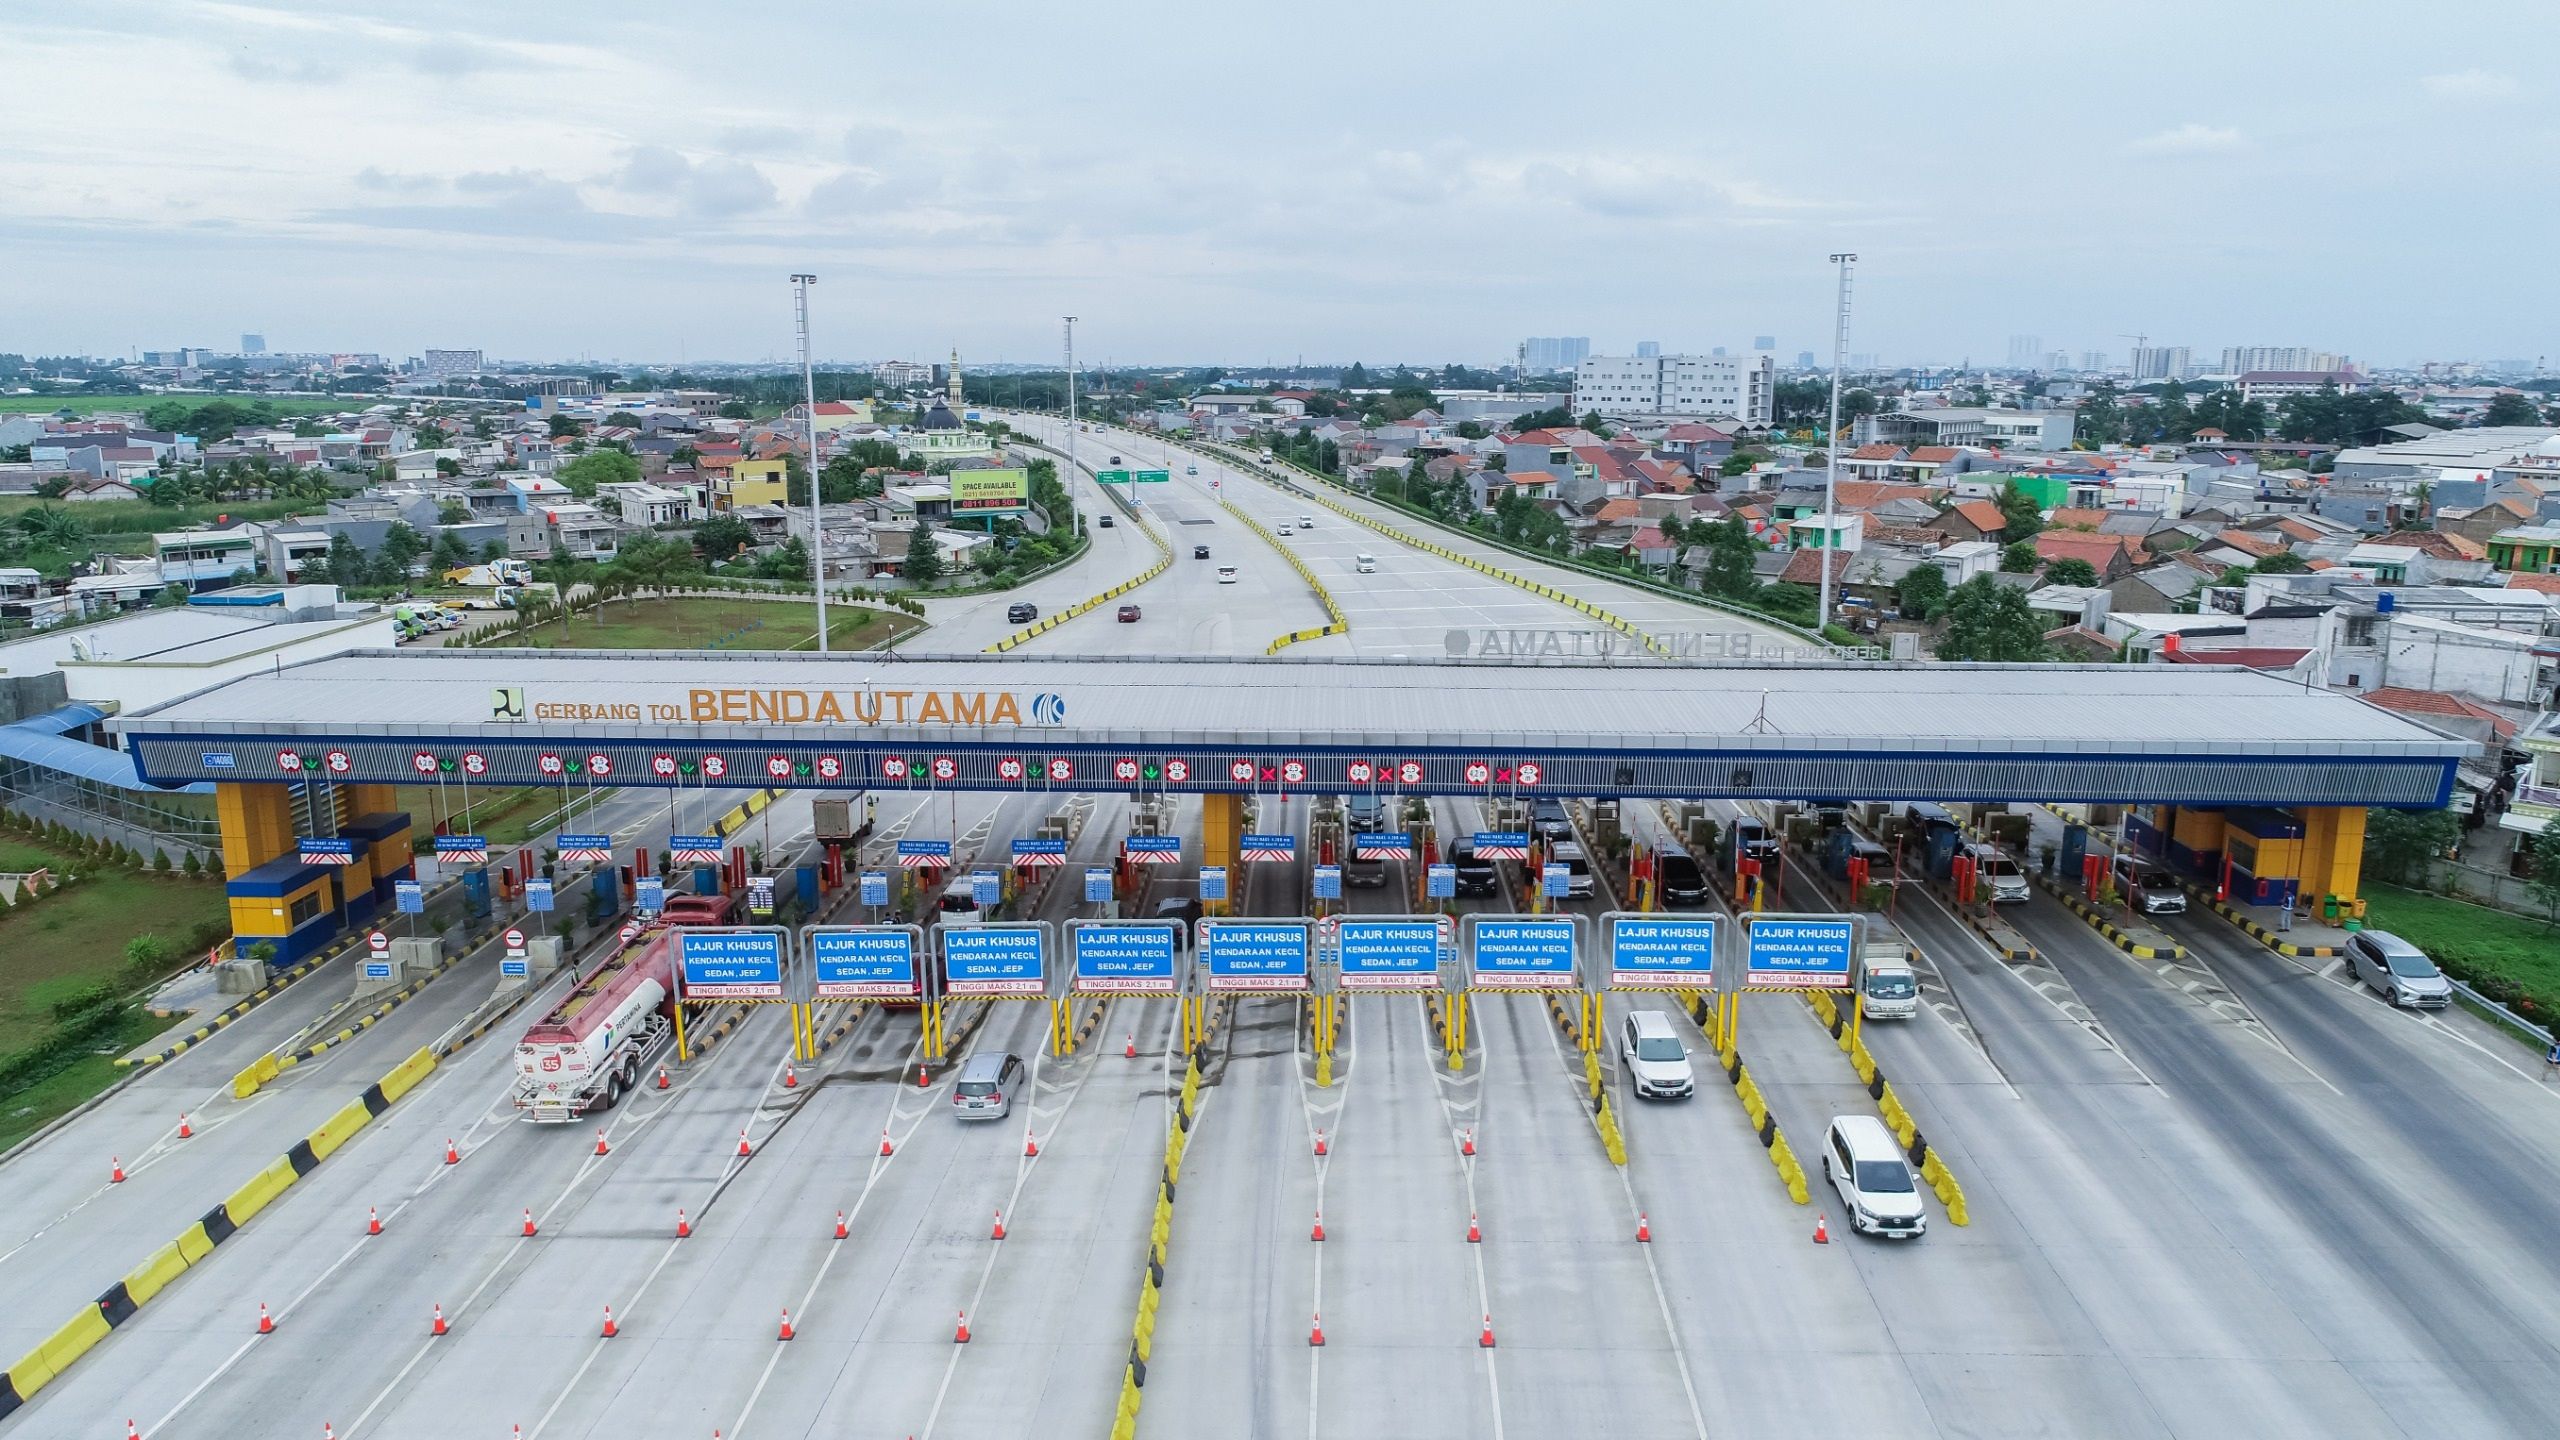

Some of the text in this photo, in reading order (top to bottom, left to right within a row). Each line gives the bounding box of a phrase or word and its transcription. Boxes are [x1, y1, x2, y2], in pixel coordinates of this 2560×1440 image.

[535, 690, 1023, 724] GERBANG TOL BENDA UTAMA
[1213, 933, 1302, 942] LAJUR KHUSUS
[1344, 930, 1433, 939] LAJUR KHUSUS
[1480, 929, 1569, 939] LAJUR KHUSUS
[1619, 928, 1710, 938] LAJUR KHUSUS
[1755, 928, 1847, 939] LAJUR KHUSUS
[949, 937, 1036, 947] LAJUR KHUSUS
[1080, 934, 1168, 944] LAJUR KHUSUS
[686, 941, 773, 951] LAJUR KHUSUS
[818, 940, 906, 950] LAJUR KHUSUS
